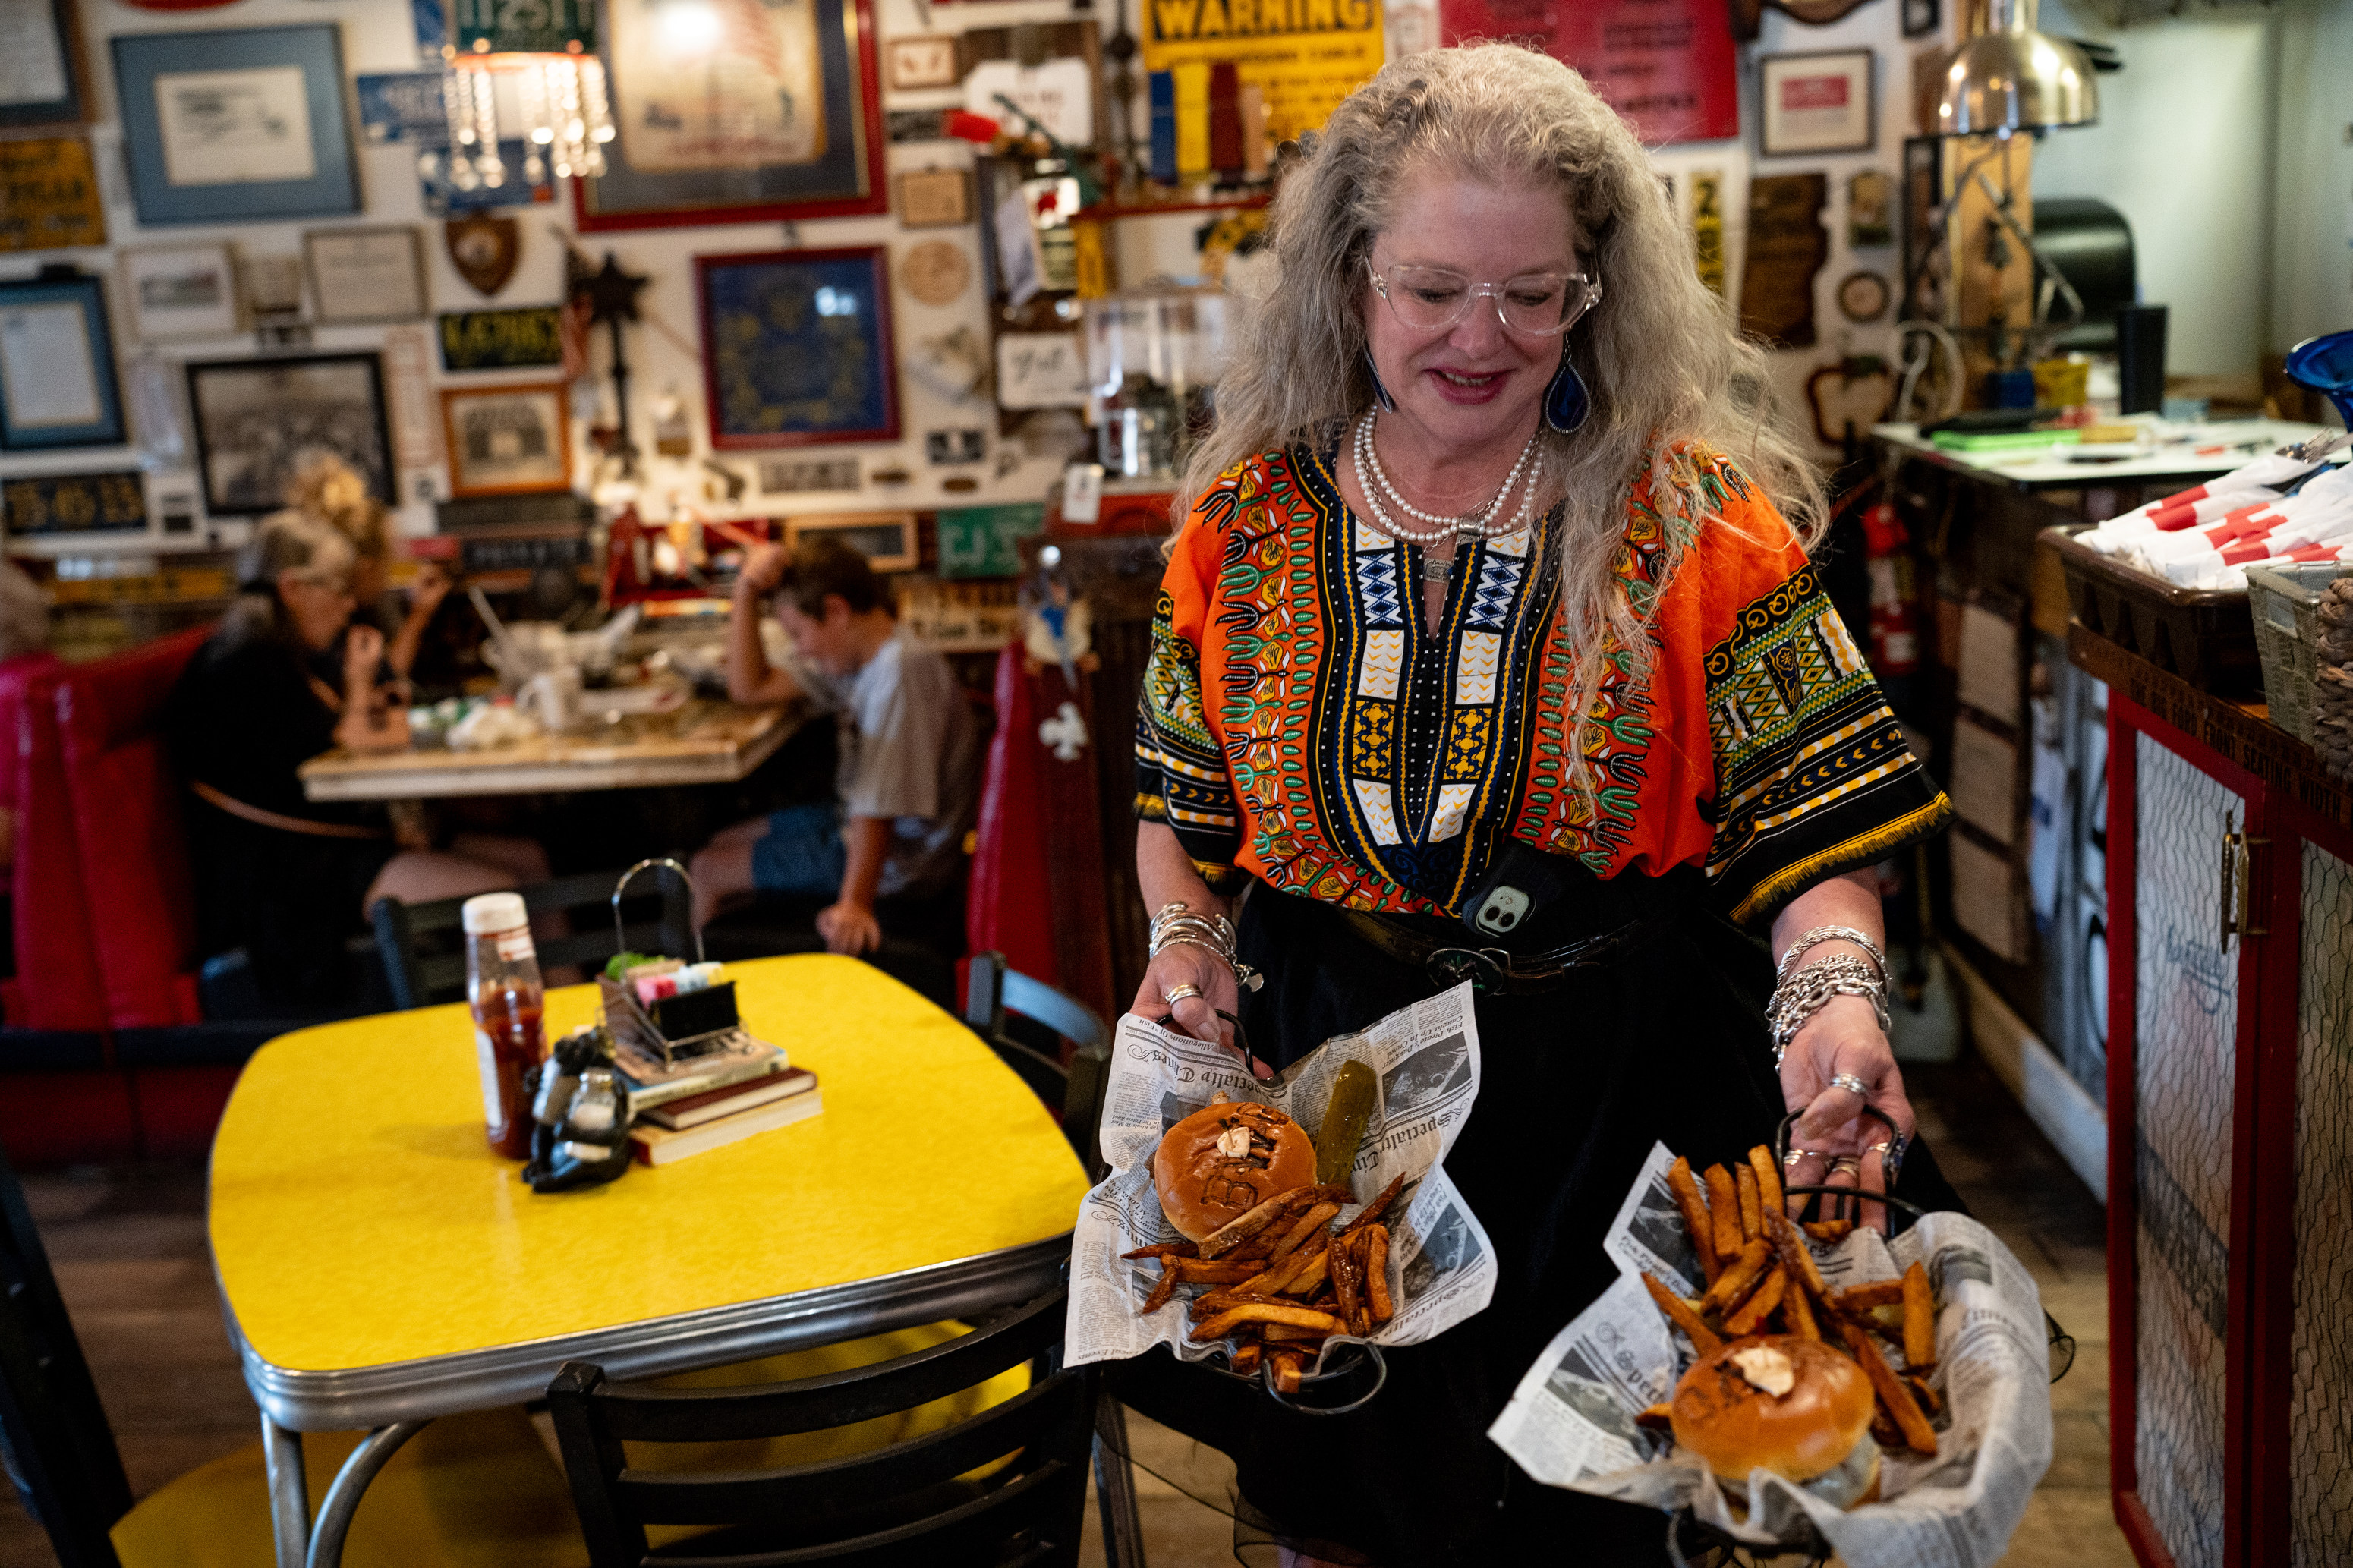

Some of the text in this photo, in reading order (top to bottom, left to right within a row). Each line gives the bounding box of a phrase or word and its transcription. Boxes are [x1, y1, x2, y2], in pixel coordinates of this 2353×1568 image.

[1151, 0, 1374, 39] WARNING
[2204, 720, 2235, 761] FRONT
[2244, 744, 2291, 794] SEATING
[2299, 773, 2339, 823] WIDTH
[1435, 1015, 1463, 1031] Caught
[1447, 1022, 1463, 1033] Fish
[1170, 1034, 1214, 1051] Allegations
[1387, 1041, 1408, 1059] Crowd
[1382, 1044, 1413, 1069] Daughter
[1151, 1050, 1273, 1104] pecialty Times
[1351, 1151, 1379, 1173] Tim
